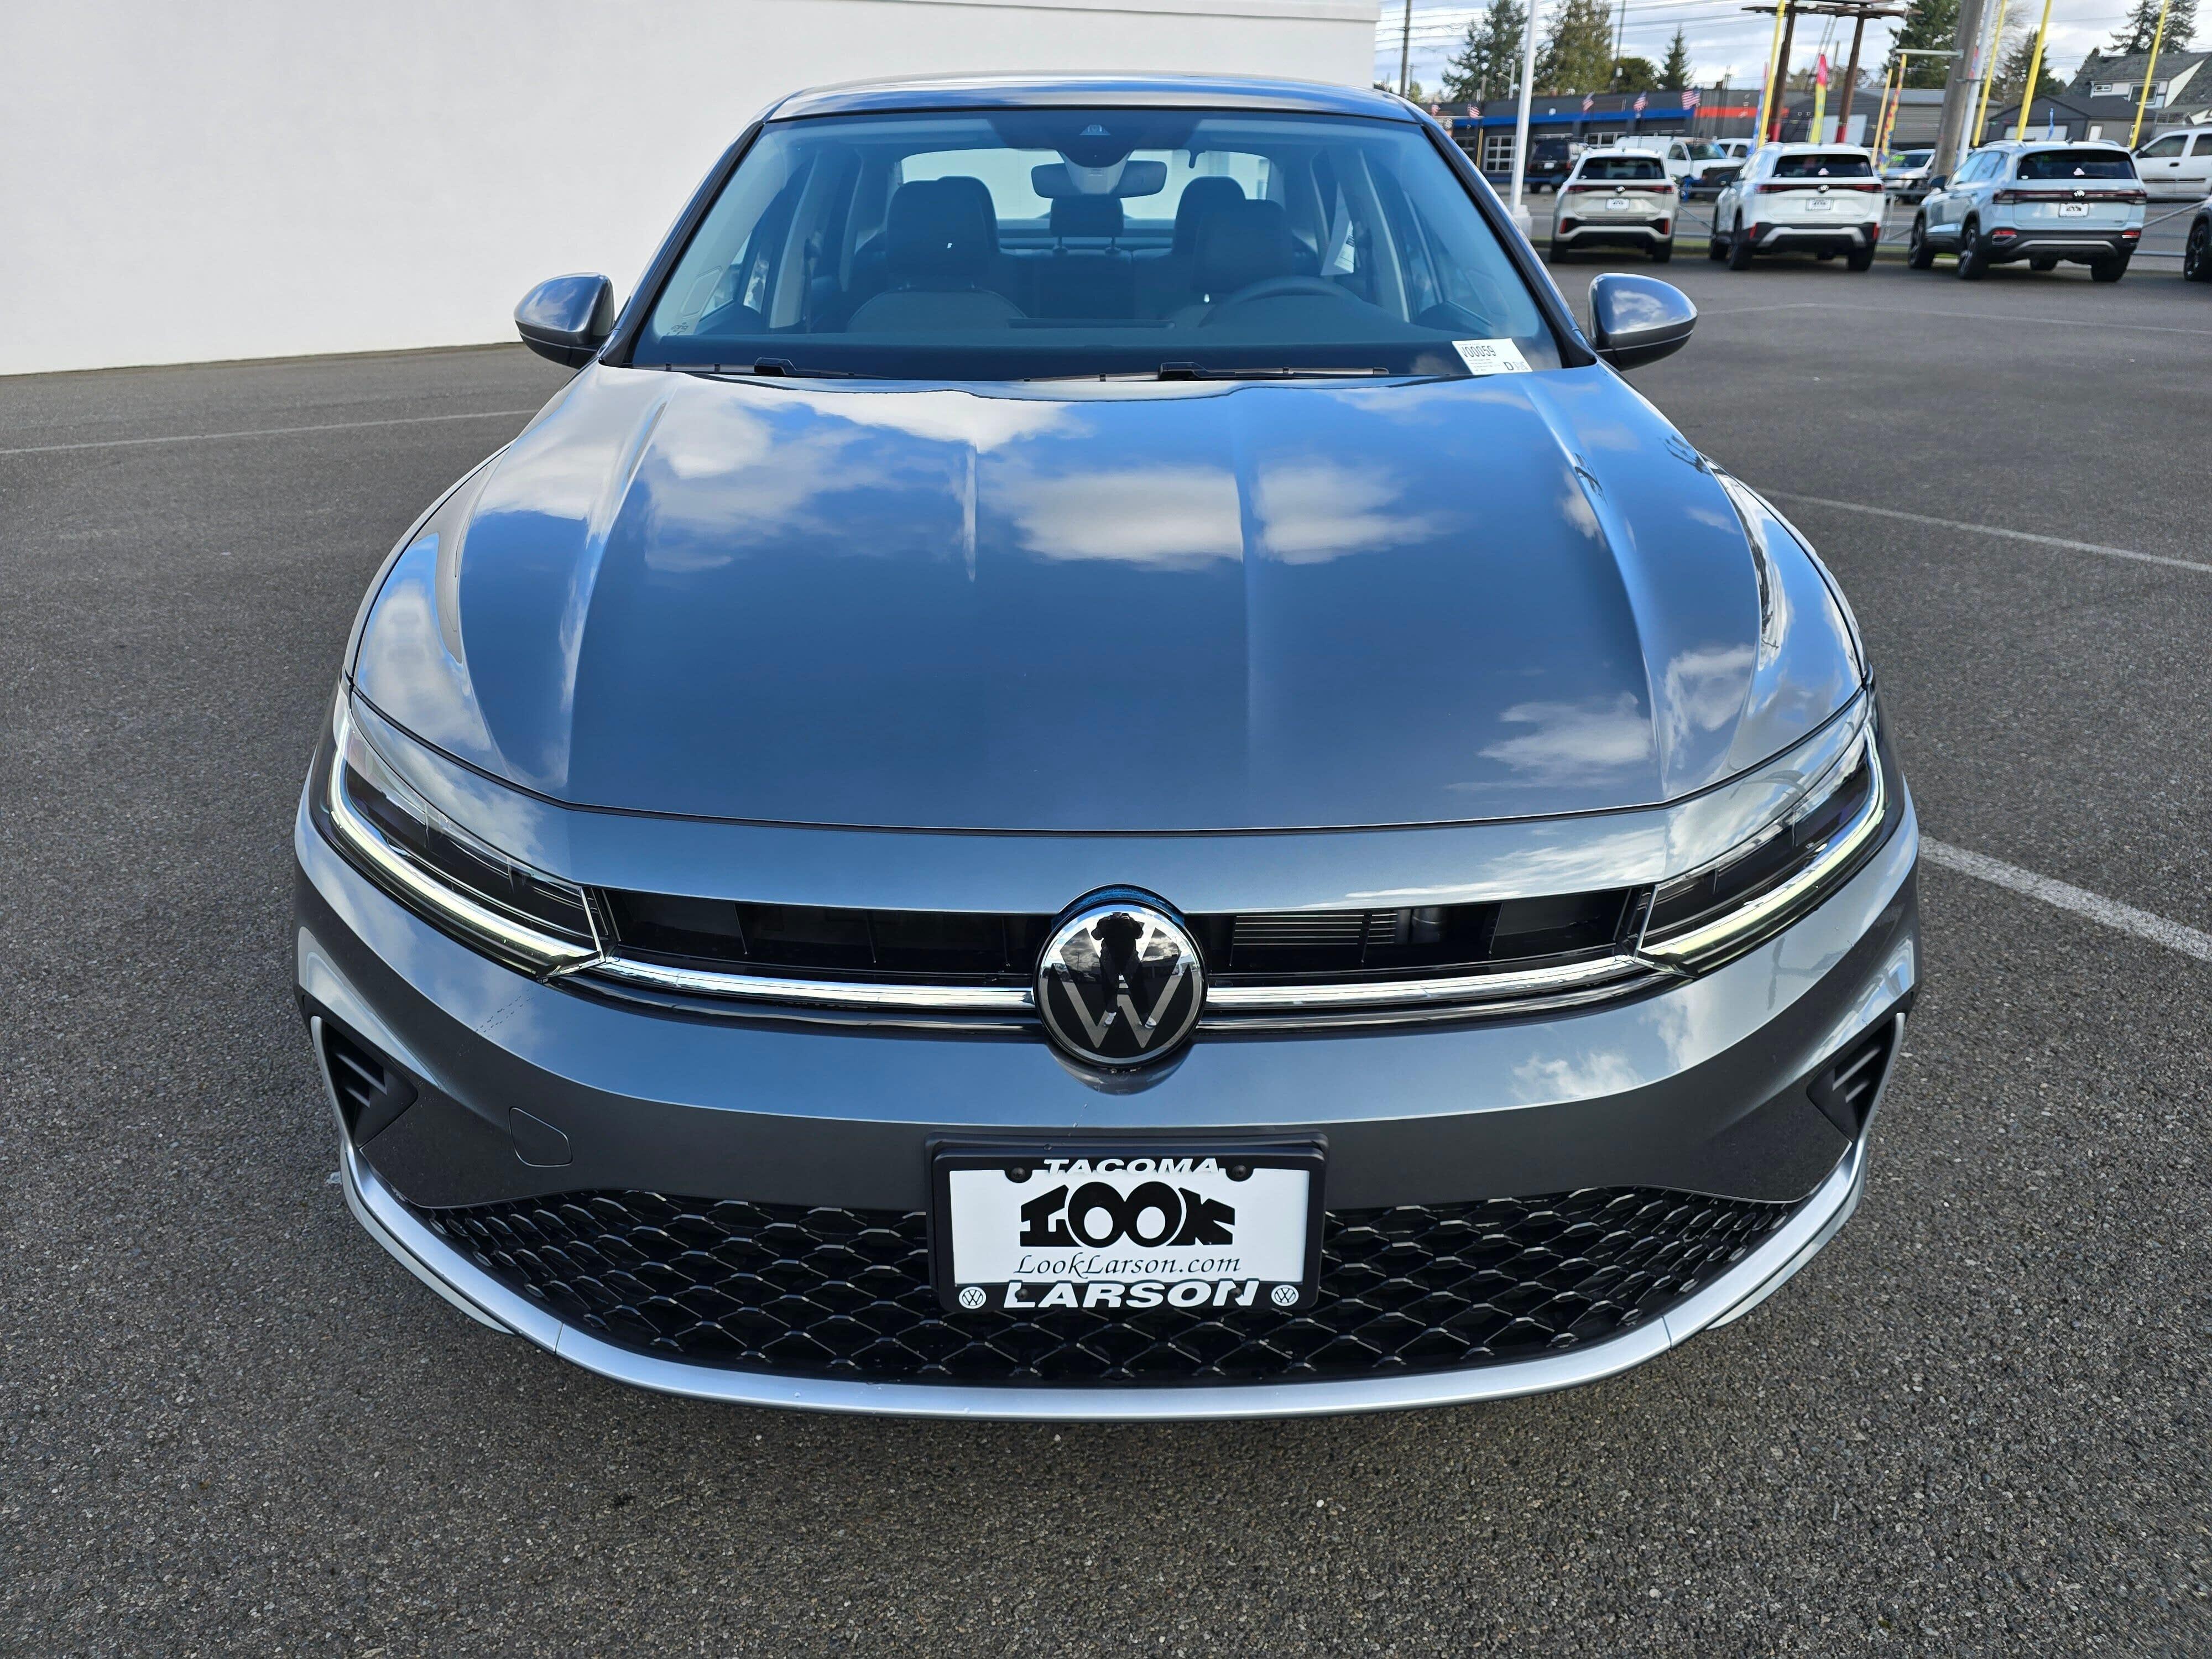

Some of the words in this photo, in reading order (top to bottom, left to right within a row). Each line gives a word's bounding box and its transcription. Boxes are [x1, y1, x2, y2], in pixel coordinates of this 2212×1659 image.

[1503, 361, 1514, 371] D
[1044, 1157, 1219, 1175] TACOMA
[1020, 1181, 1236, 1248] LOOK
[1013, 1251, 1241, 1279] LookLarson.com
[1003, 1280, 1260, 1308] LARSON
